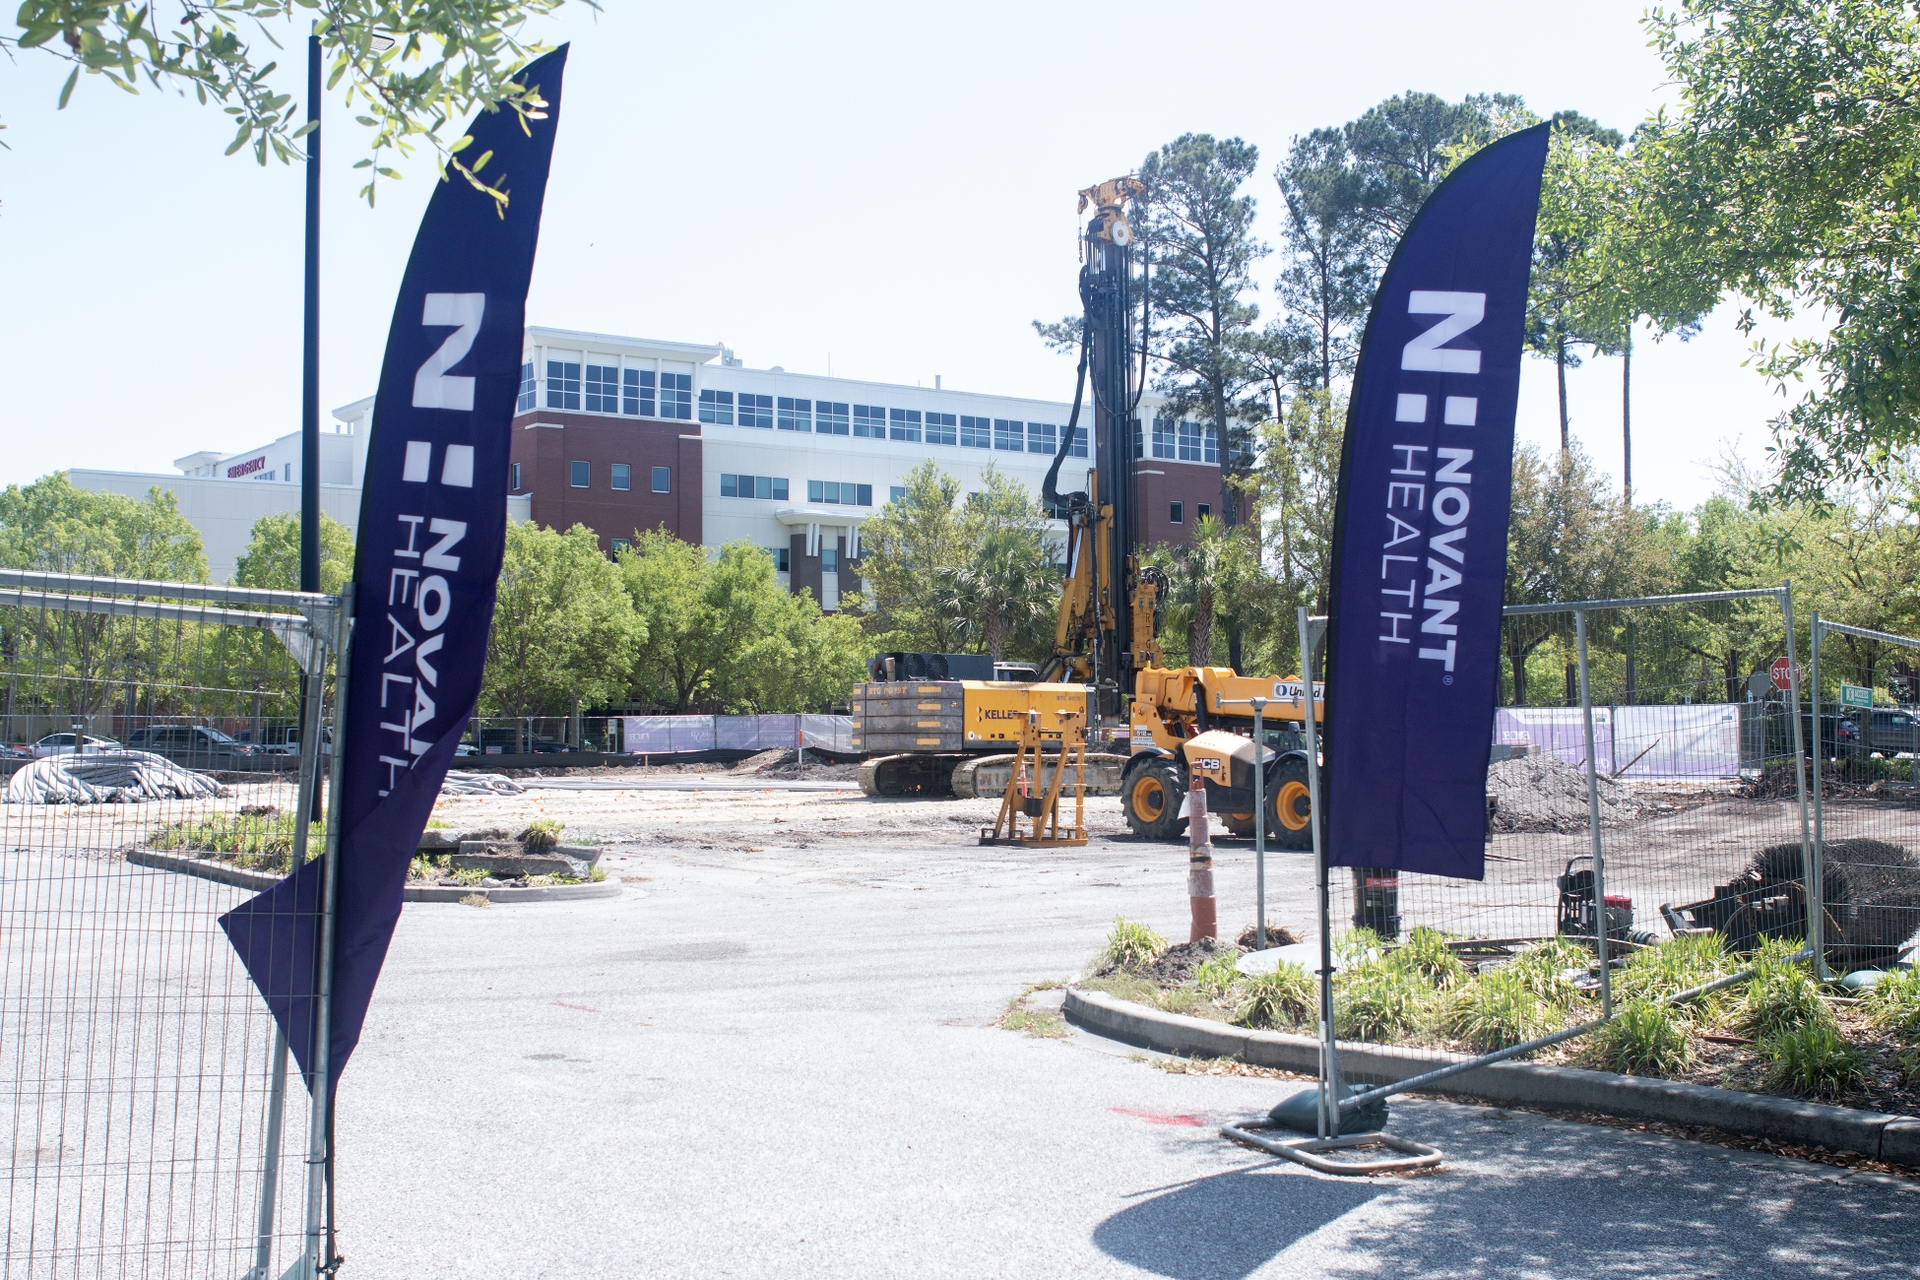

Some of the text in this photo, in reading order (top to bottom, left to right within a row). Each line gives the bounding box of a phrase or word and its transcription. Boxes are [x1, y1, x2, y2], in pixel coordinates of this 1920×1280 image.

[227, 455, 266, 479] EMERGENCY
[1379, 444, 1428, 644] HEALTH
[1418, 447, 1474, 672] NOVANT
[411, 517, 468, 770] NOVA
[1773, 667, 1797, 680] STO
[1289, 685, 1321, 698] Unid
[985, 709, 1019, 720] KELLE
